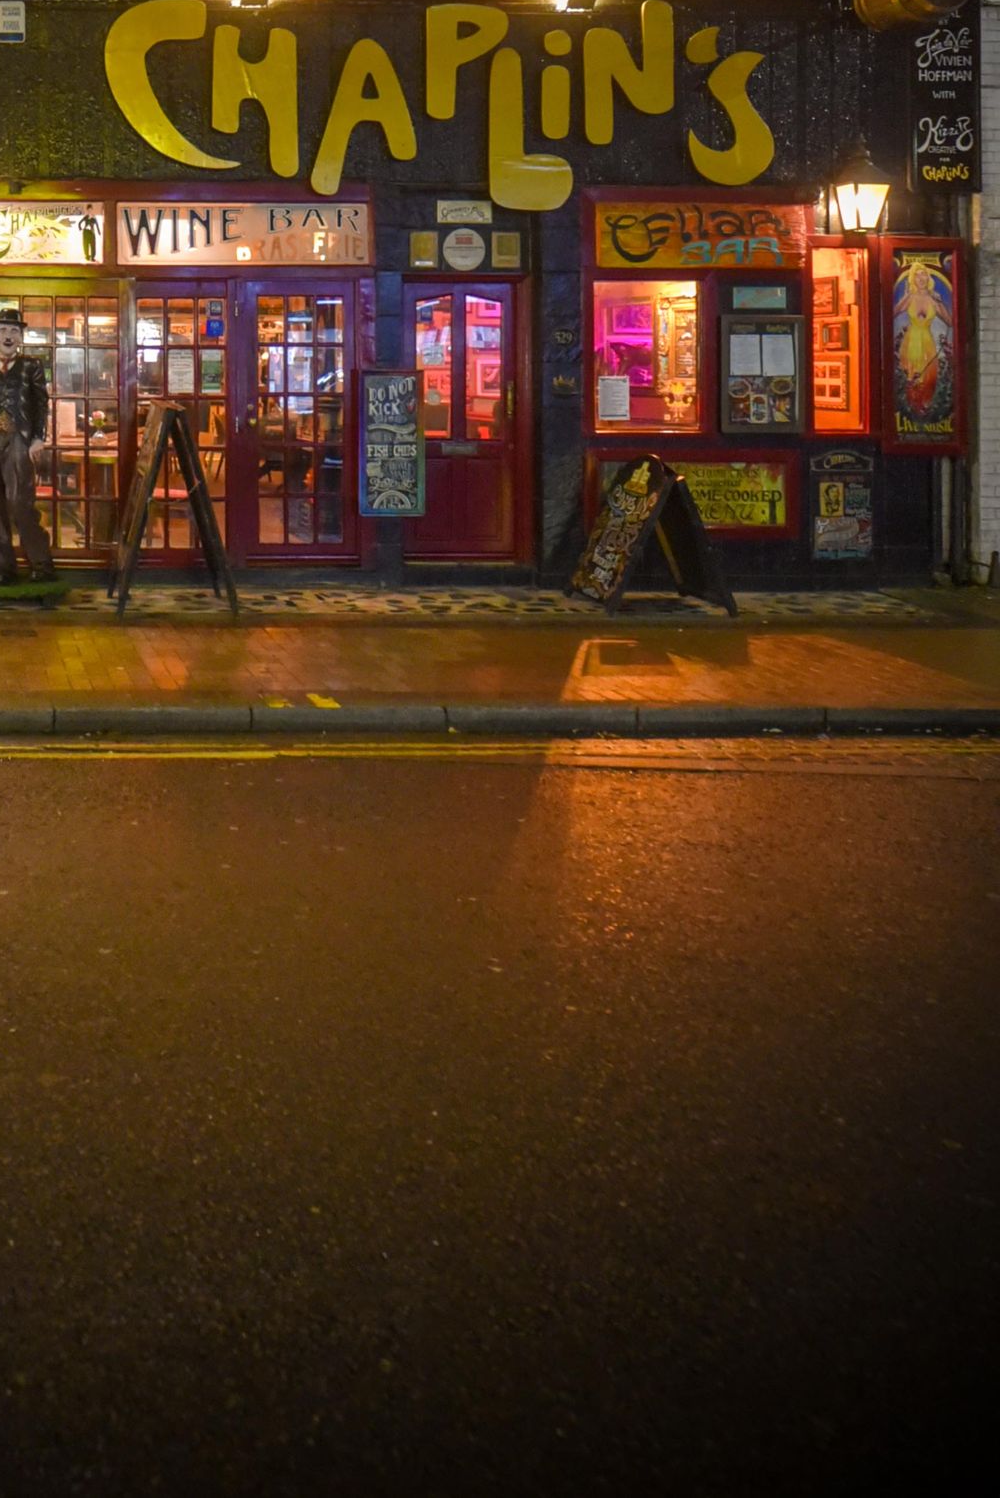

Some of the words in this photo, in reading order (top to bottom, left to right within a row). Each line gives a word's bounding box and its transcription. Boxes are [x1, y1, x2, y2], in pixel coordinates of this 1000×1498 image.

[934, 55, 972, 67] VIVIEN
[918, 69, 972, 82] HOFFMAN
[932, 90, 956, 99] WITH
[121, 207, 244, 257] WINE
[266, 206, 361, 234] BAR
[679, 237, 785, 266] BAR
[368, 387, 386, 402] DO
[388, 376, 417, 401] NOT
[368, 399, 401, 416] KICK
[366, 444, 389, 457] FISH
[393, 444, 418, 457] CHIPS
[692, 488, 722, 503] OME
[724, 488, 783, 503] COOKED
